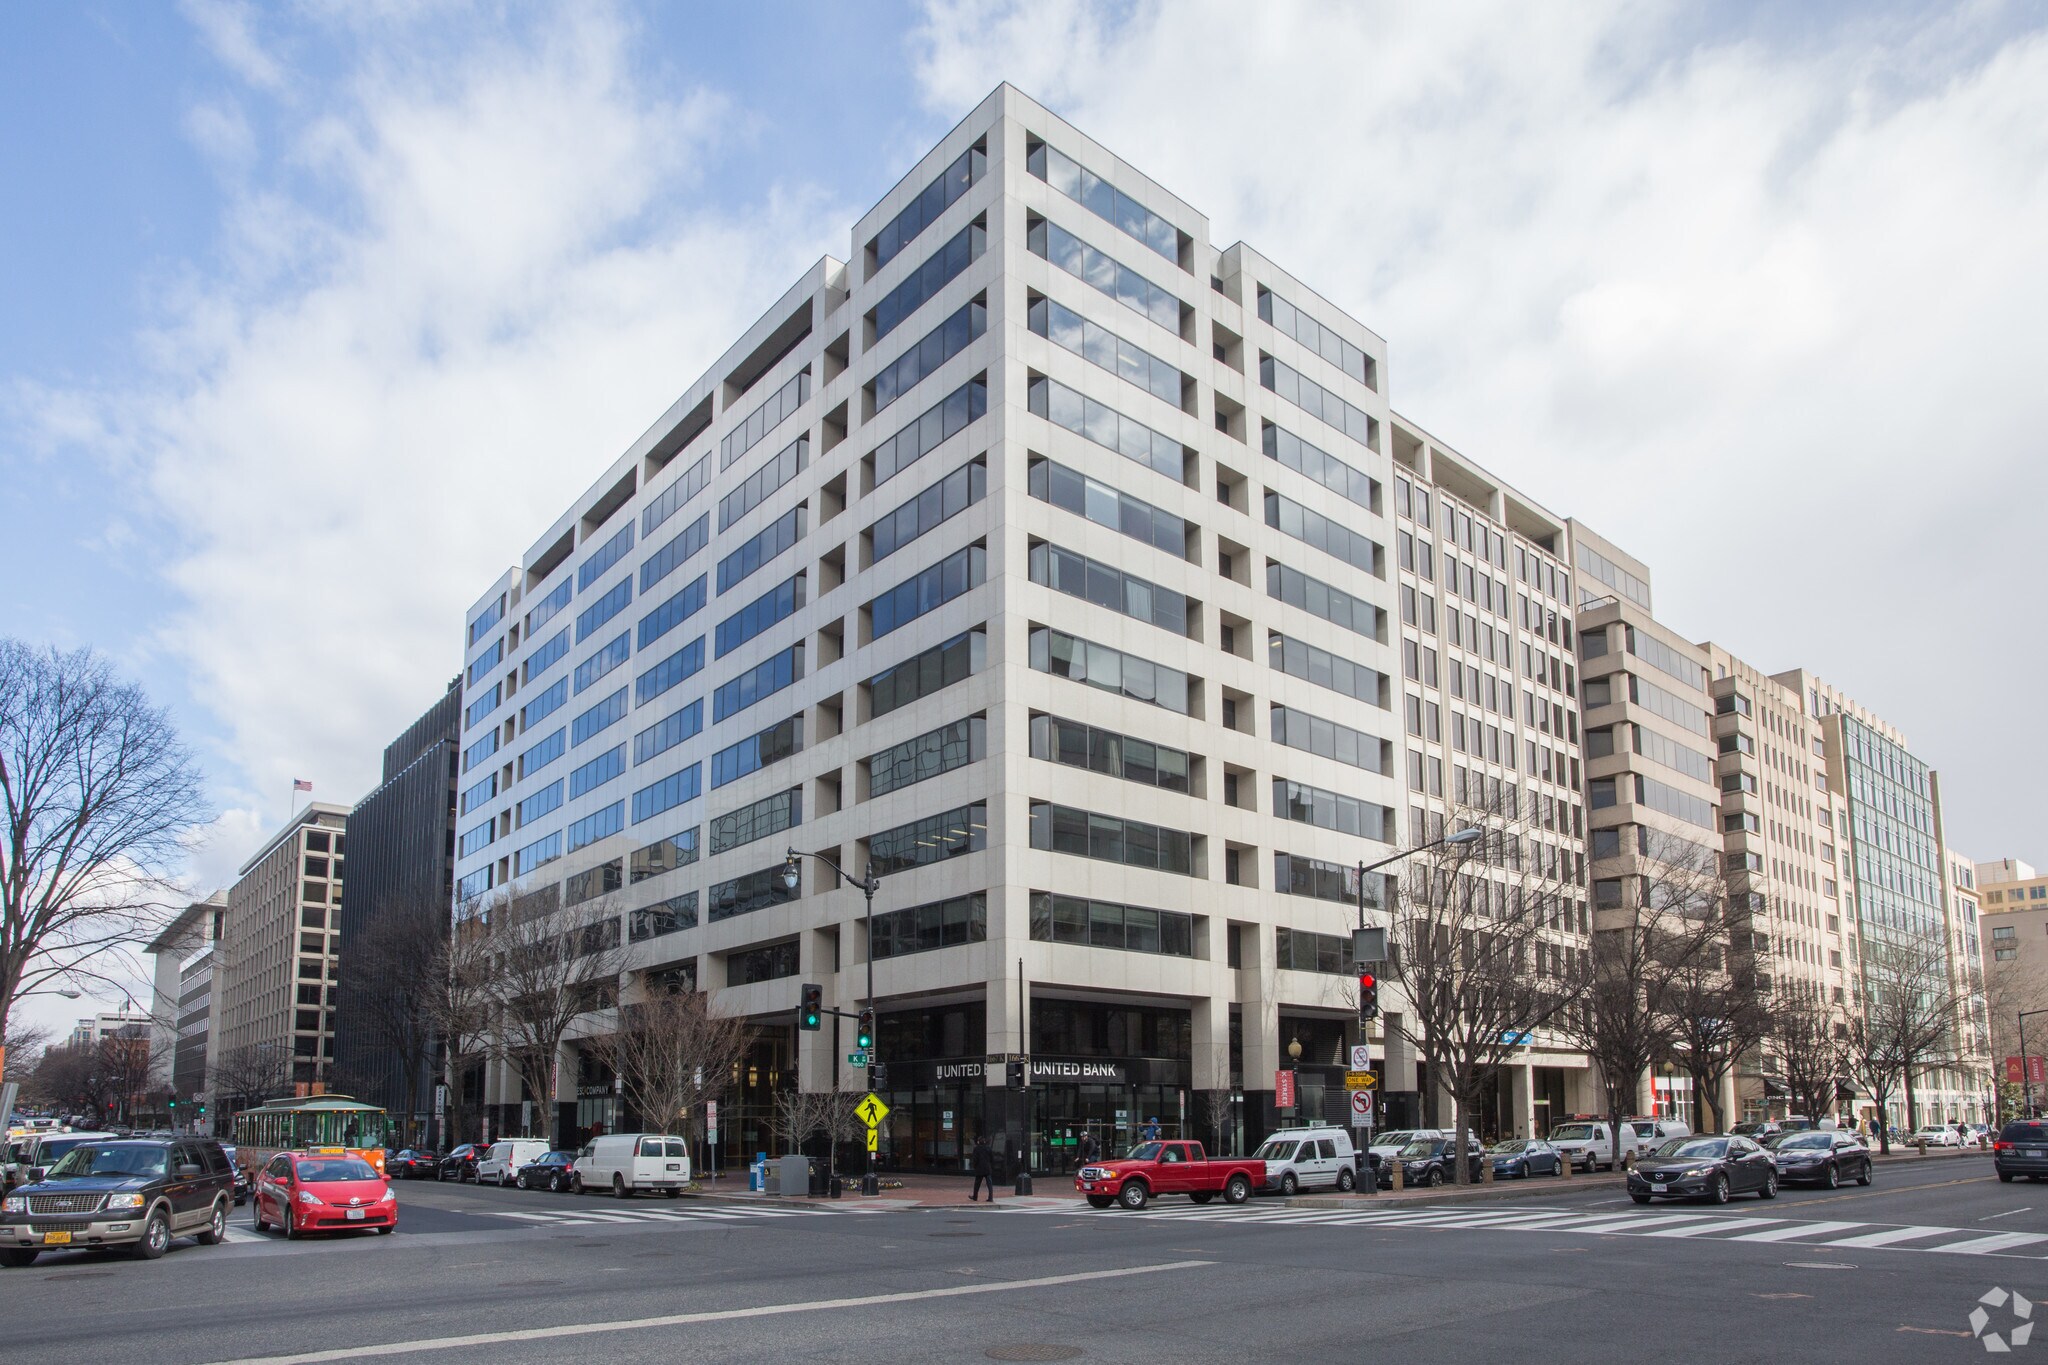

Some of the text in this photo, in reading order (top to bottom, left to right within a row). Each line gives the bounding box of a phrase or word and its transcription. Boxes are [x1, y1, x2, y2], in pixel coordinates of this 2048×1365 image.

[944, 1063, 982, 1078] UNITED
[1033, 1062, 1116, 1077] UNITED BANK
